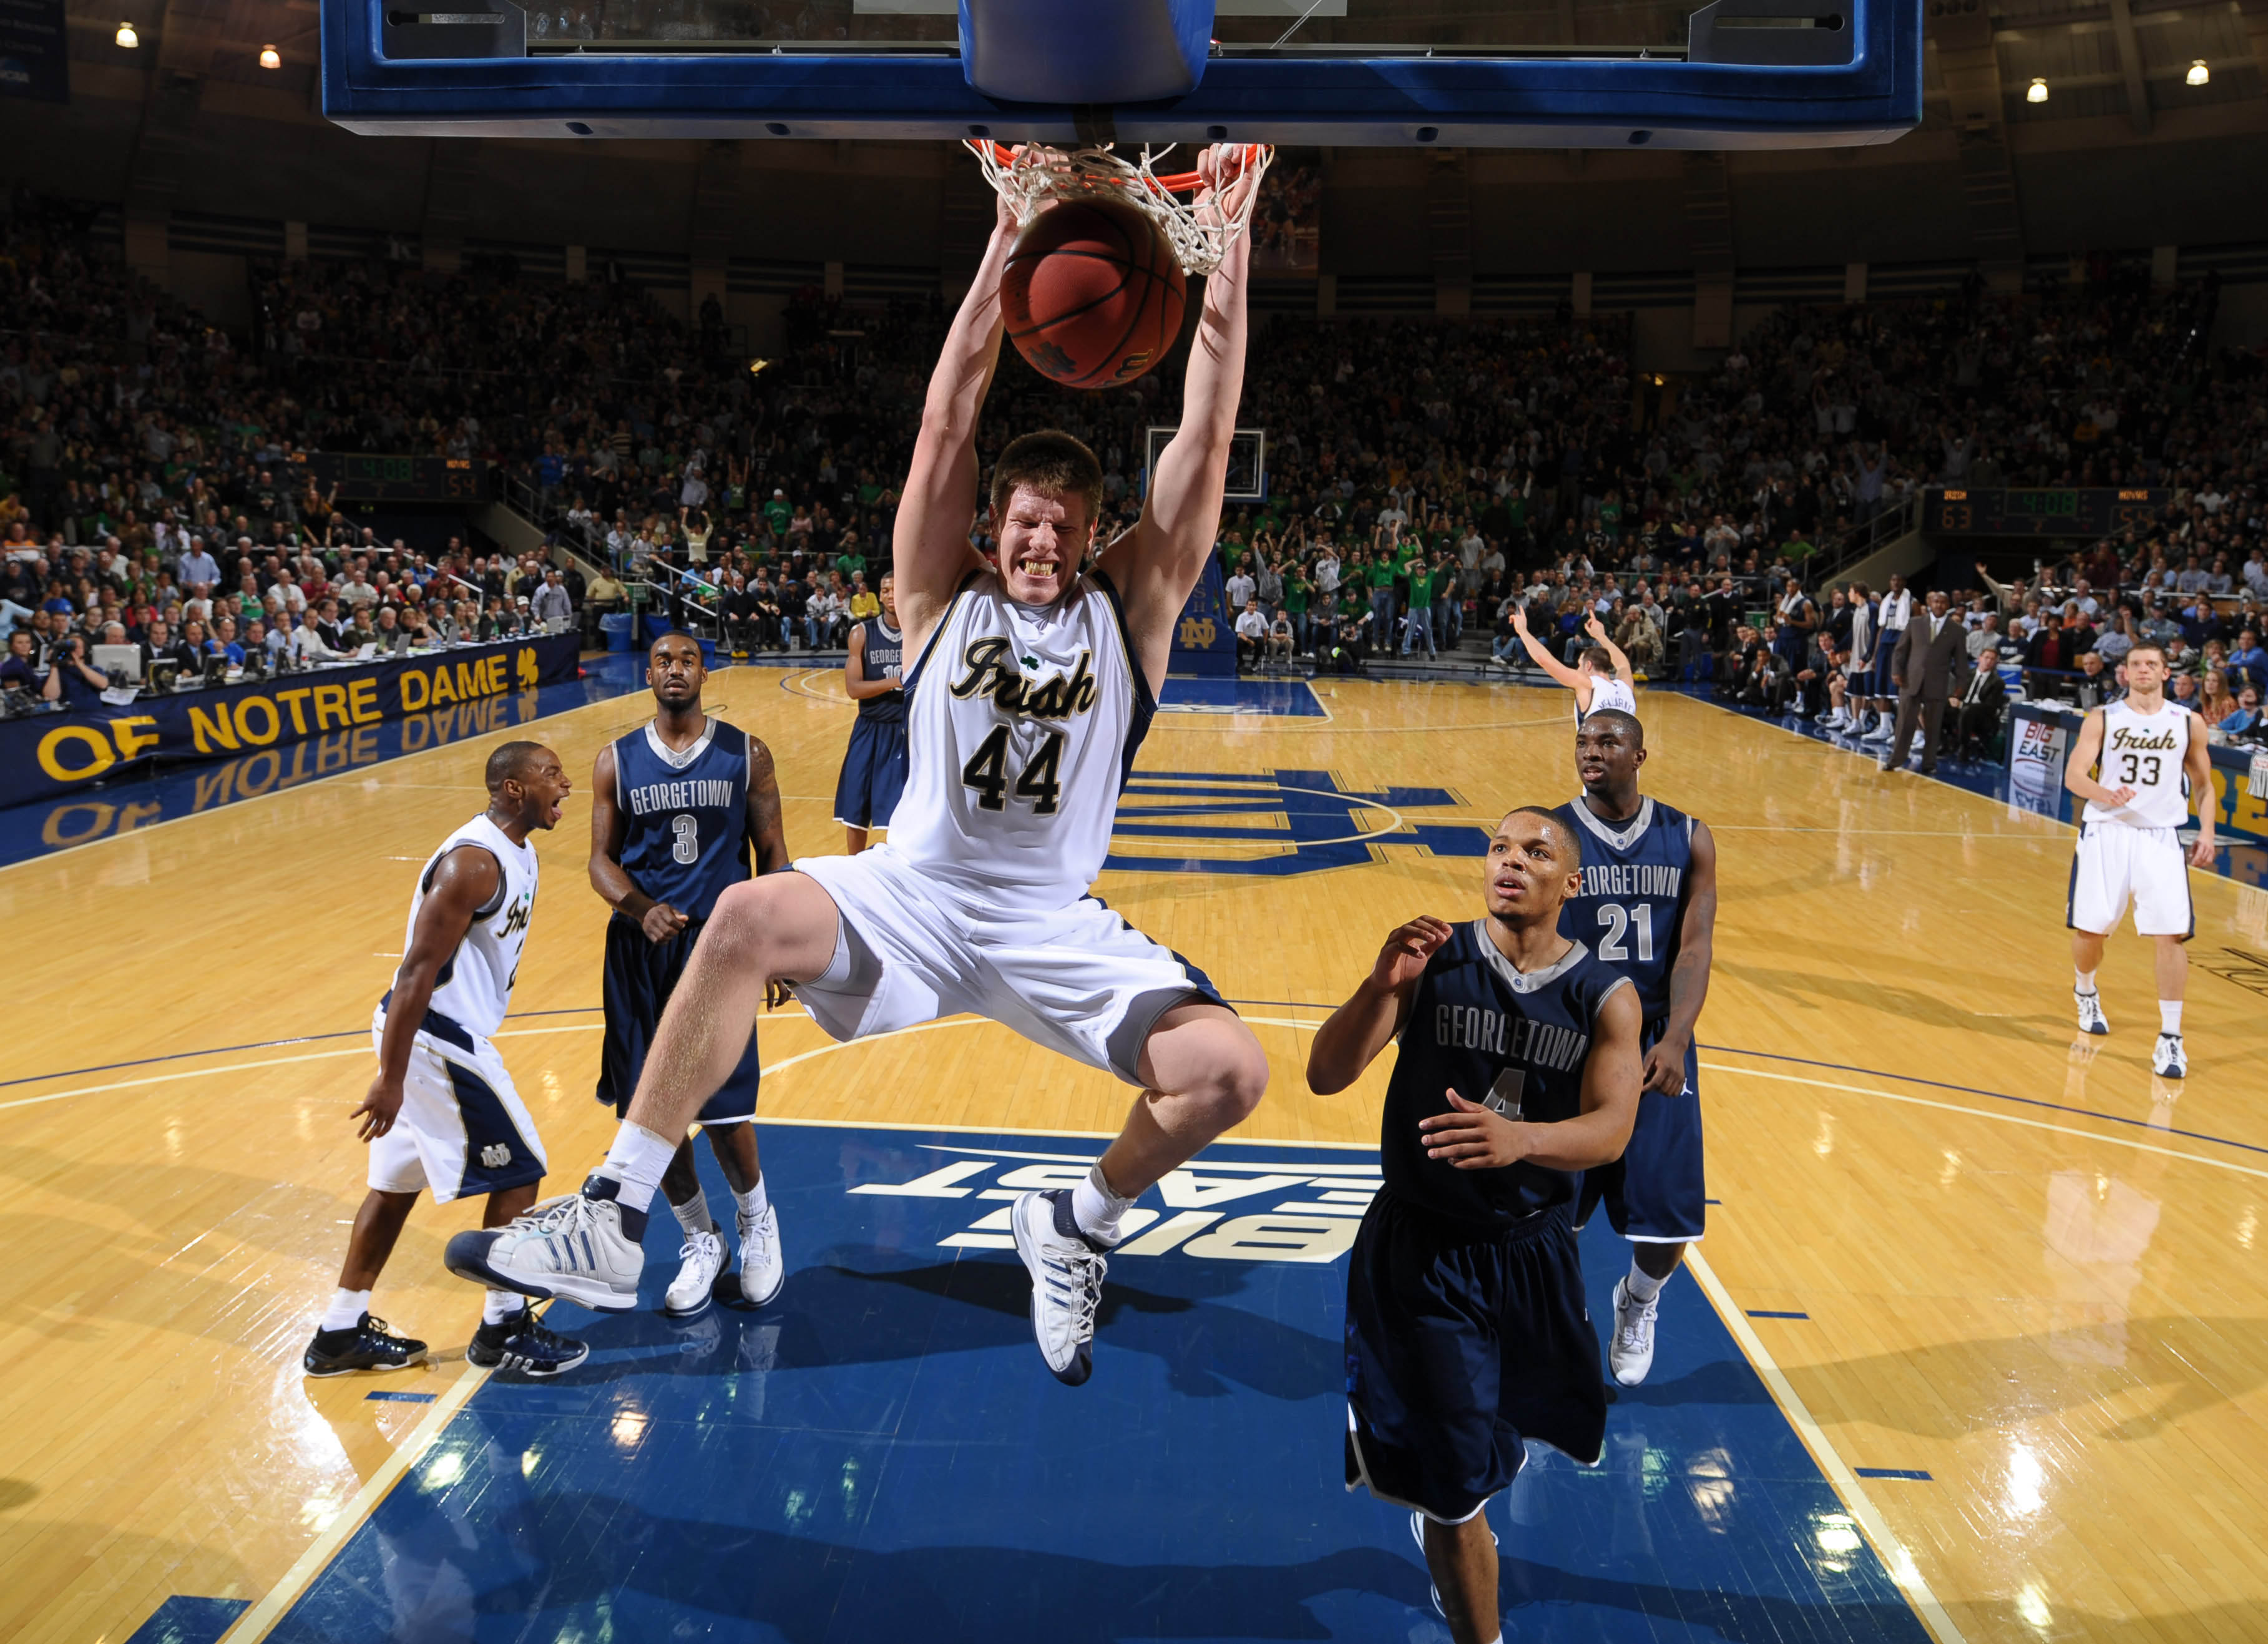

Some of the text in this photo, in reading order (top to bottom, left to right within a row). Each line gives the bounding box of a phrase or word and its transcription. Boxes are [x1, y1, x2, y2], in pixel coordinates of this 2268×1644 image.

[949, 635, 1098, 722] Irish
[37, 654, 509, 781] OF NOTRE DAME
[2025, 720, 2055, 743] BIG
[2111, 727, 2177, 751] Irish
[962, 723, 1065, 818] 44
[2018, 740, 2061, 763] EAST
[2119, 754, 2161, 786] 33
[630, 780, 733, 815] GEORGETOWN
[672, 814, 698, 864] 3
[1574, 864, 1681, 898] EORGETOWN
[1597, 903, 1653, 961] 21
[1435, 1004, 1588, 1073] GEORGETOWN
[1482, 1067, 1527, 1122] 4
